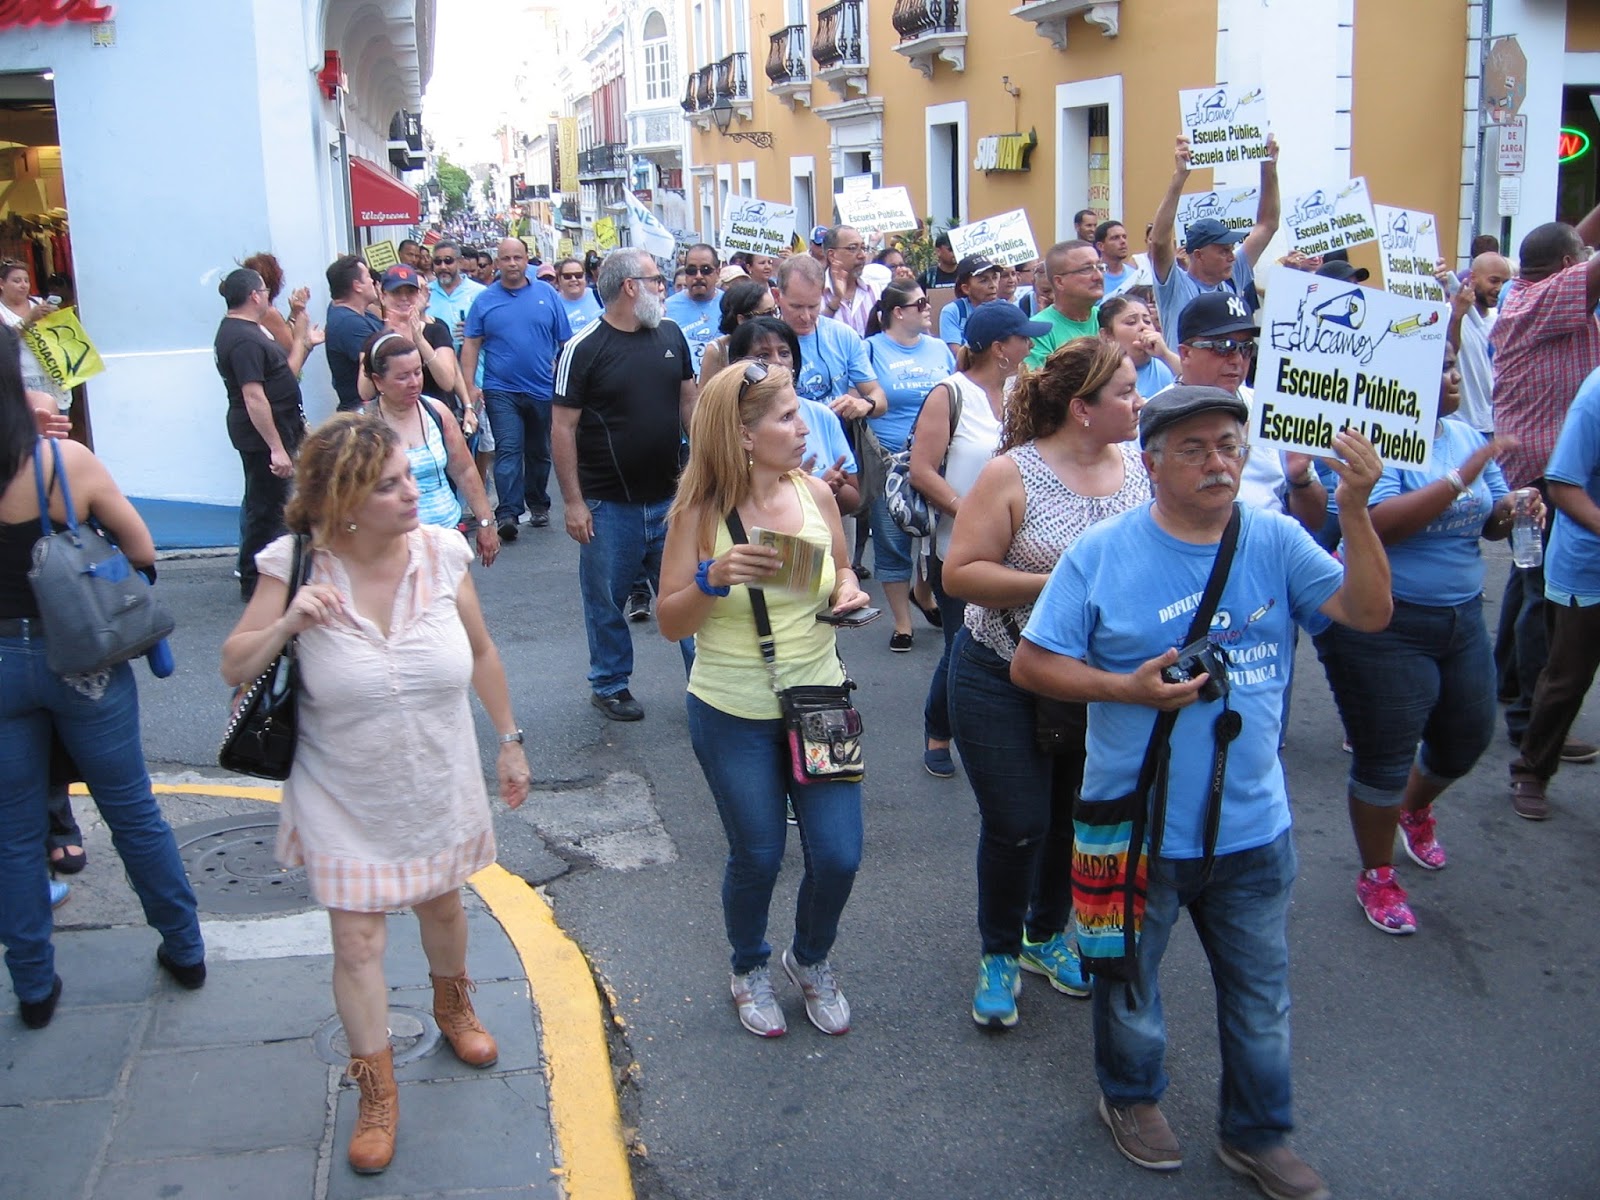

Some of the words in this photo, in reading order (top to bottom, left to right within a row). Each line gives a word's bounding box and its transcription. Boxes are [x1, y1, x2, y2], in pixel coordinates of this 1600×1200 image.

[1192, 127, 1227, 144] Escuela
[1228, 124, 1262, 141] Pública,
[1507, 131, 1517, 140] DE
[973, 130, 1035, 171] SUBWAY
[1190, 148, 1224, 166] Escuela
[1226, 145, 1239, 162] del
[1241, 143, 1268, 160] Pueblo
[1500, 144, 1523, 152] CARGA
[361, 210, 410, 222] Walgreens
[848, 212, 876, 223] Escuela
[856, 224, 876, 233] cuela
[889, 219, 914, 229] Pueblo
[731, 222, 758, 237] Escuela
[759, 227, 785, 244] Pública,
[1294, 221, 1329, 240] Escuela
[1330, 213, 1366, 230] Pública,
[724, 236, 751, 251] Escuela
[752, 240, 763, 253] del
[994, 238, 1027, 253] Pública,
[1330, 233, 1344, 248] del
[1345, 226, 1374, 244] Pueblo
[1008, 248, 1035, 263] Pueblo
[1276, 357, 1349, 404] Escuela
[1353, 372, 1421, 424] Pública,
[1259, 402, 1333, 449] Escuela
[1338, 418, 1366, 438] dl
[1370, 421, 1426, 465] Pueblo
[1158, 590, 1204, 623] DEFIEN
